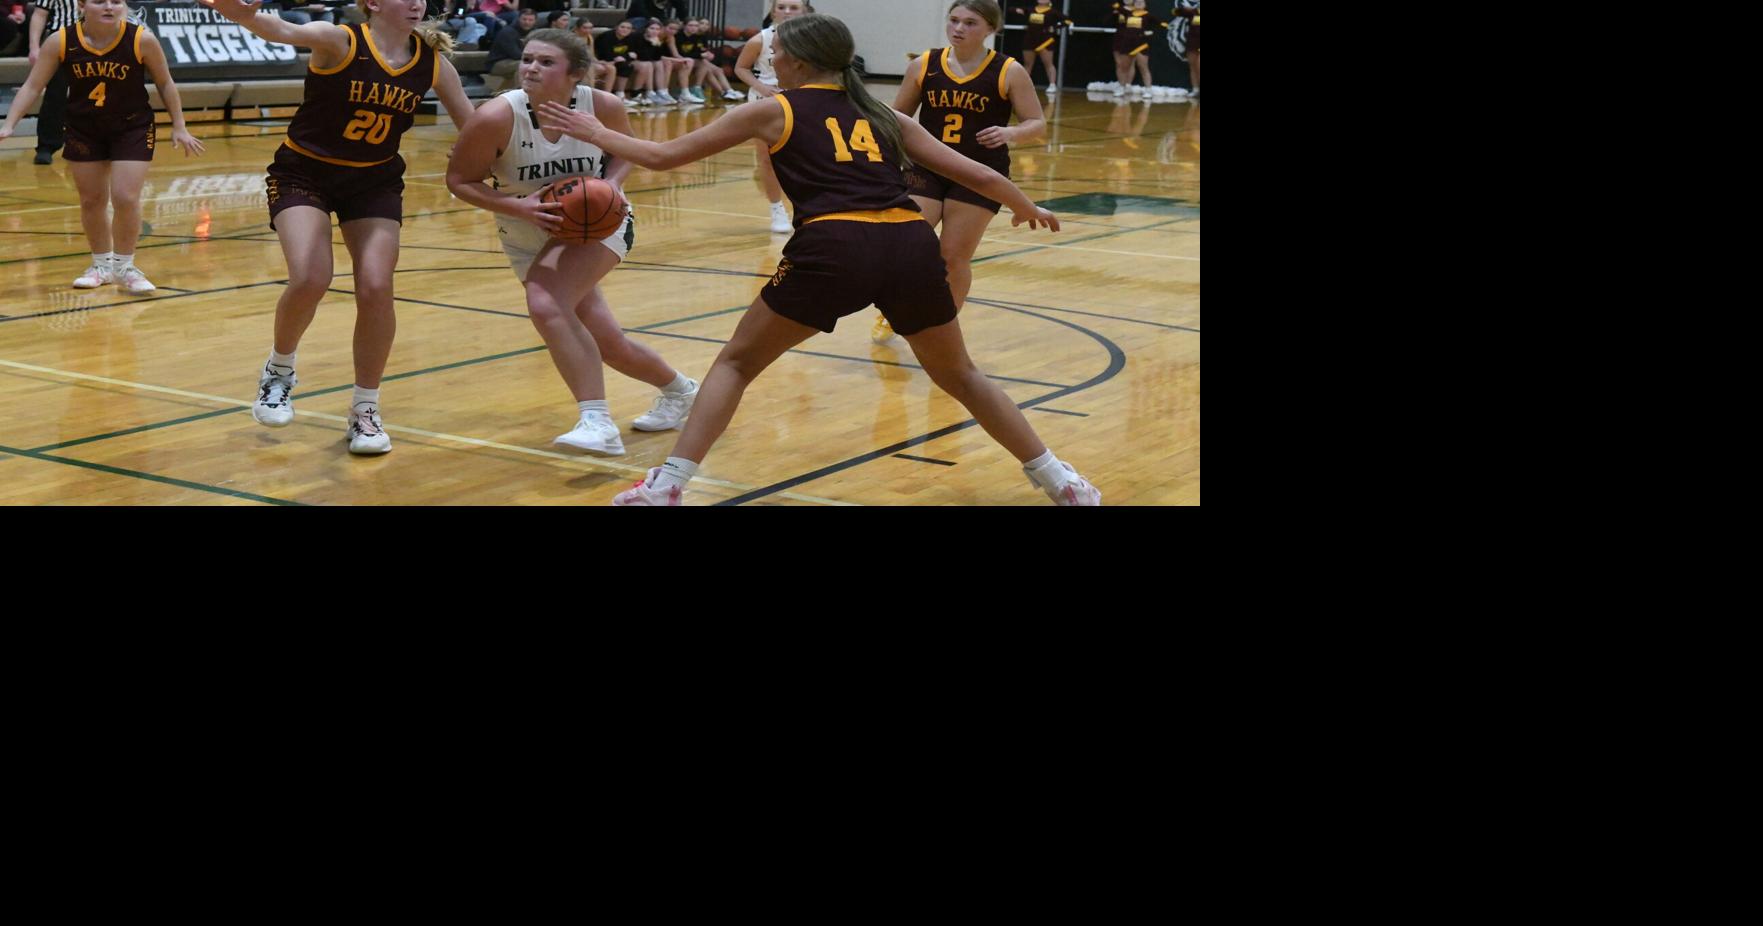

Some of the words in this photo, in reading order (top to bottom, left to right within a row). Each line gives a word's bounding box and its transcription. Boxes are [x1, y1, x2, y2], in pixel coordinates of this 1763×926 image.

[155, 7, 210, 23] TRINITY
[158, 25, 297, 63] TIGERS
[72, 61, 130, 80] HAWKS
[88, 81, 106, 107] 4
[349, 80, 421, 113] HAWKS
[927, 89, 989, 112] HAWKS
[342, 109, 393, 145] 20
[825, 117, 884, 162] 14
[942, 113, 963, 143] 2
[517, 156, 595, 181] TRINITY
